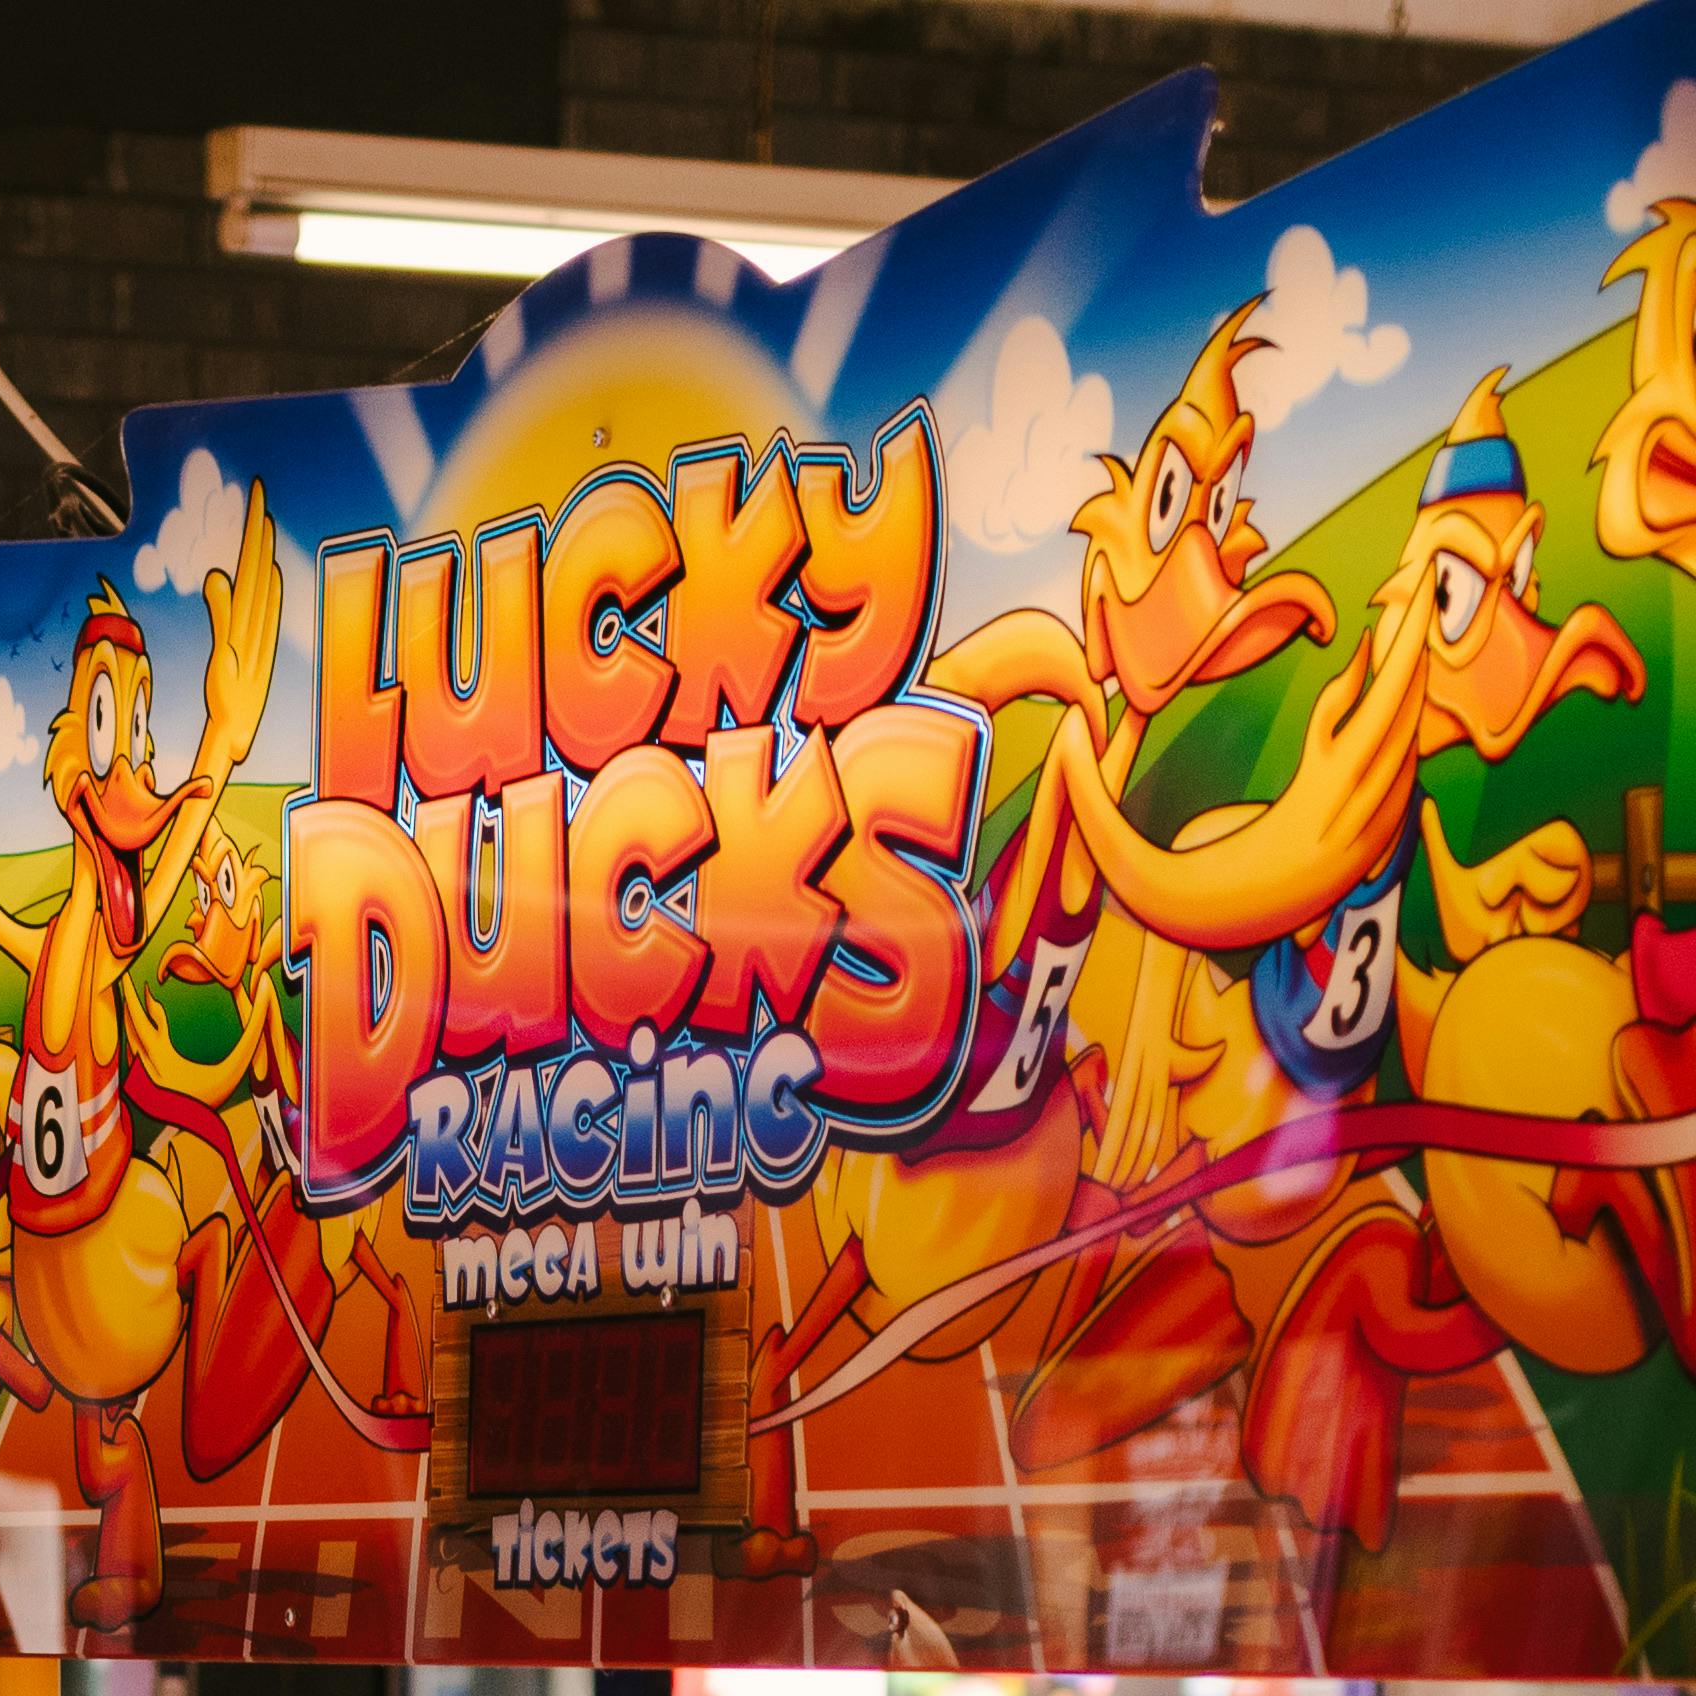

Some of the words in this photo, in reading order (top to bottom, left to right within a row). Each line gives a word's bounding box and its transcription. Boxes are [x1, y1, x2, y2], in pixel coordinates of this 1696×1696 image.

[312, 408, 940, 812] LUCKY
[288, 718, 980, 1160] DUCKS
[1330, 918, 1382, 1038] 3
[1013, 964, 1068, 1090] 5
[33, 1085, 67, 1180] 6
